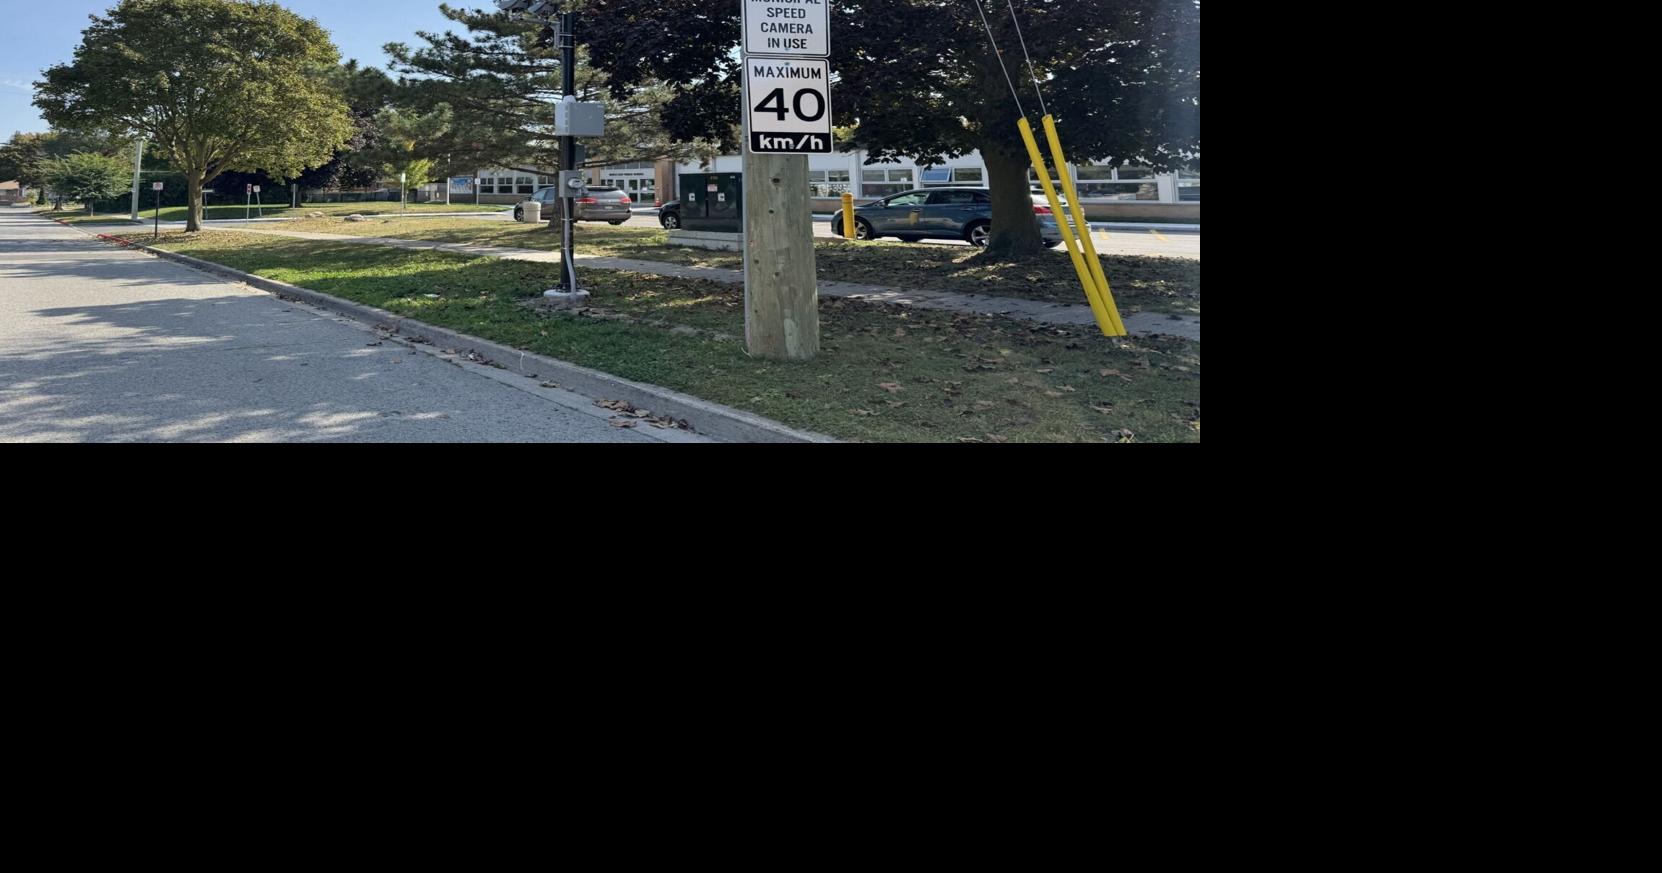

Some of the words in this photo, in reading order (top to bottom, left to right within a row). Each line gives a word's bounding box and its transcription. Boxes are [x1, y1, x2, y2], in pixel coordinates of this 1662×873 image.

[766, 7, 806, 19] SPEED
[760, 22, 813, 34] CAMERA
[767, 37, 780, 48] IN
[783, 38, 808, 49] USE
[753, 65, 822, 80] MAXIMUM
[753, 87, 826, 122] 40
[759, 134, 824, 150] km/h
